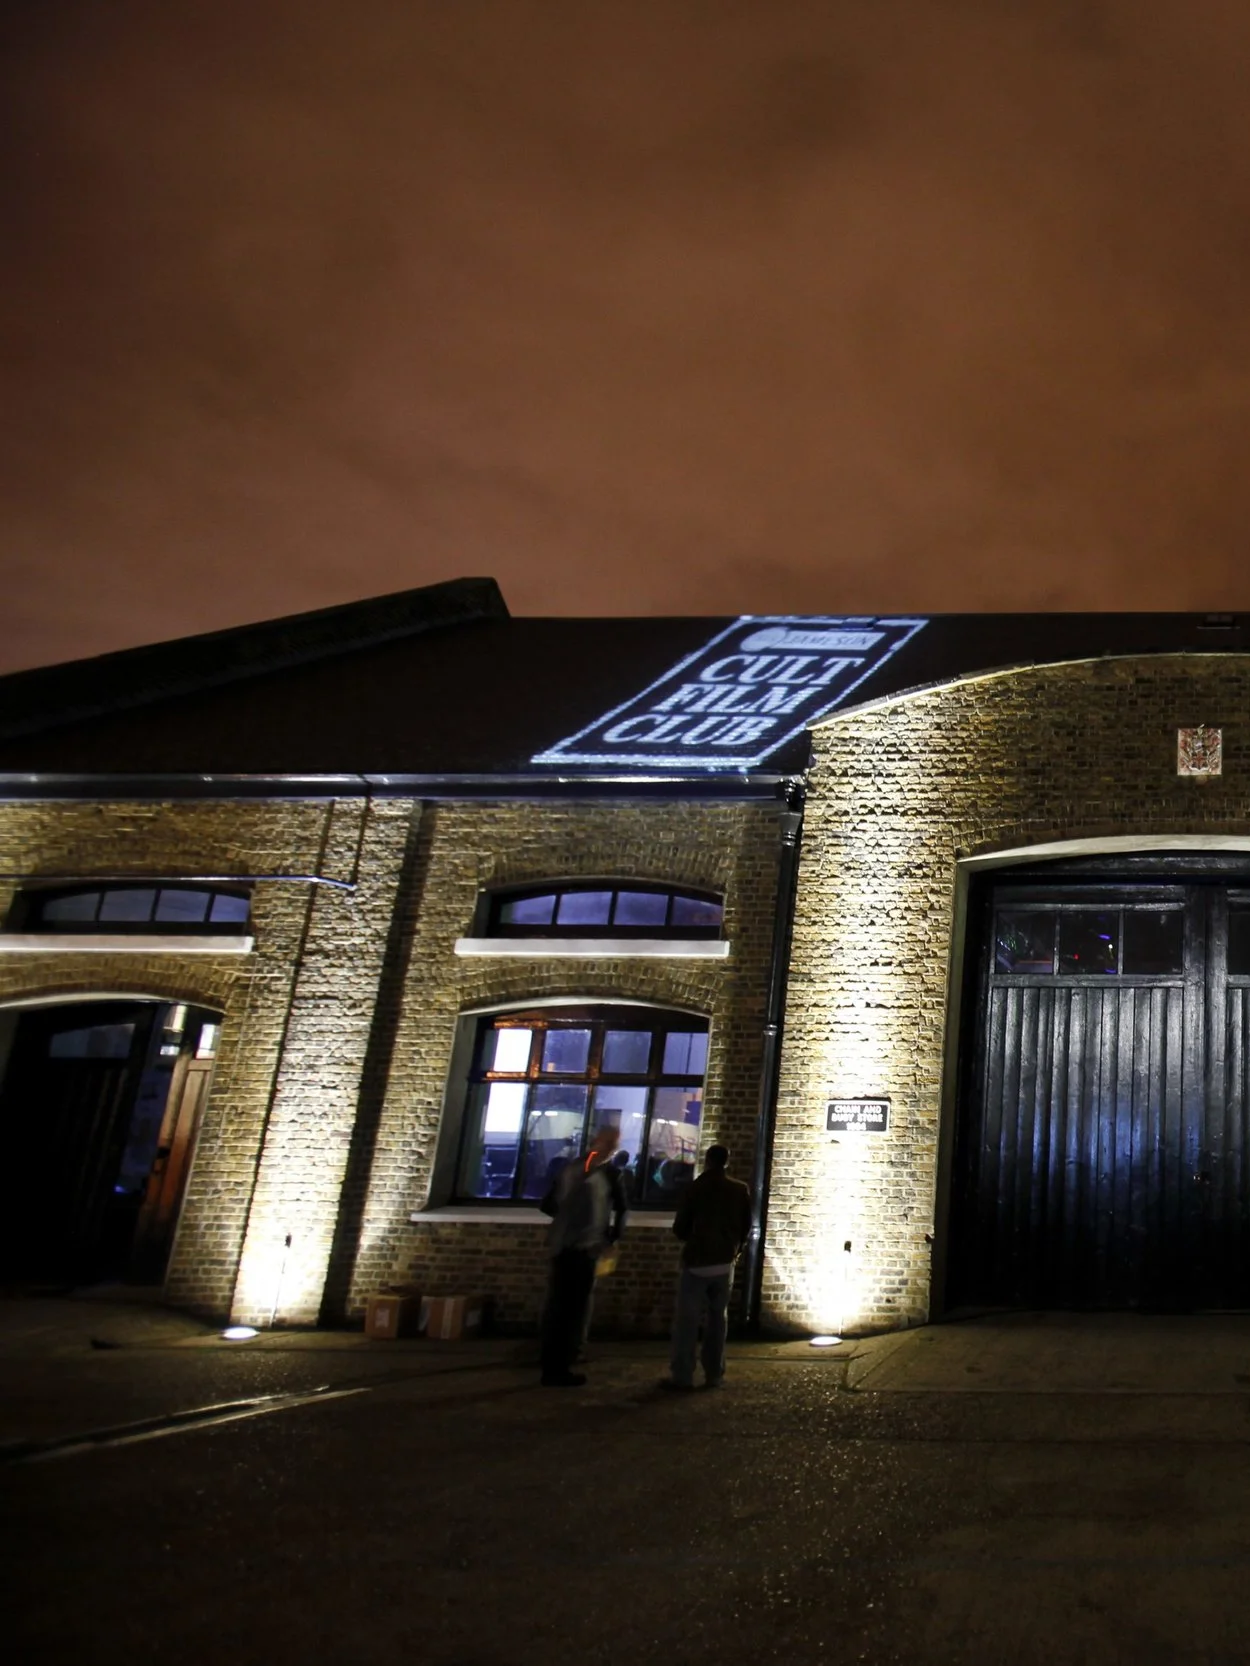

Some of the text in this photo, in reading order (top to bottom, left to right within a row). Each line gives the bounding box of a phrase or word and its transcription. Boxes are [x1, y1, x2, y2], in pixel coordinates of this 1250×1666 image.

[701, 654, 866, 685] CULT
[651, 684, 824, 714] FILM
[602, 714, 779, 745] CLUB
[857, 1113, 883, 1122] STORE
[863, 1105, 882, 1114] AND
